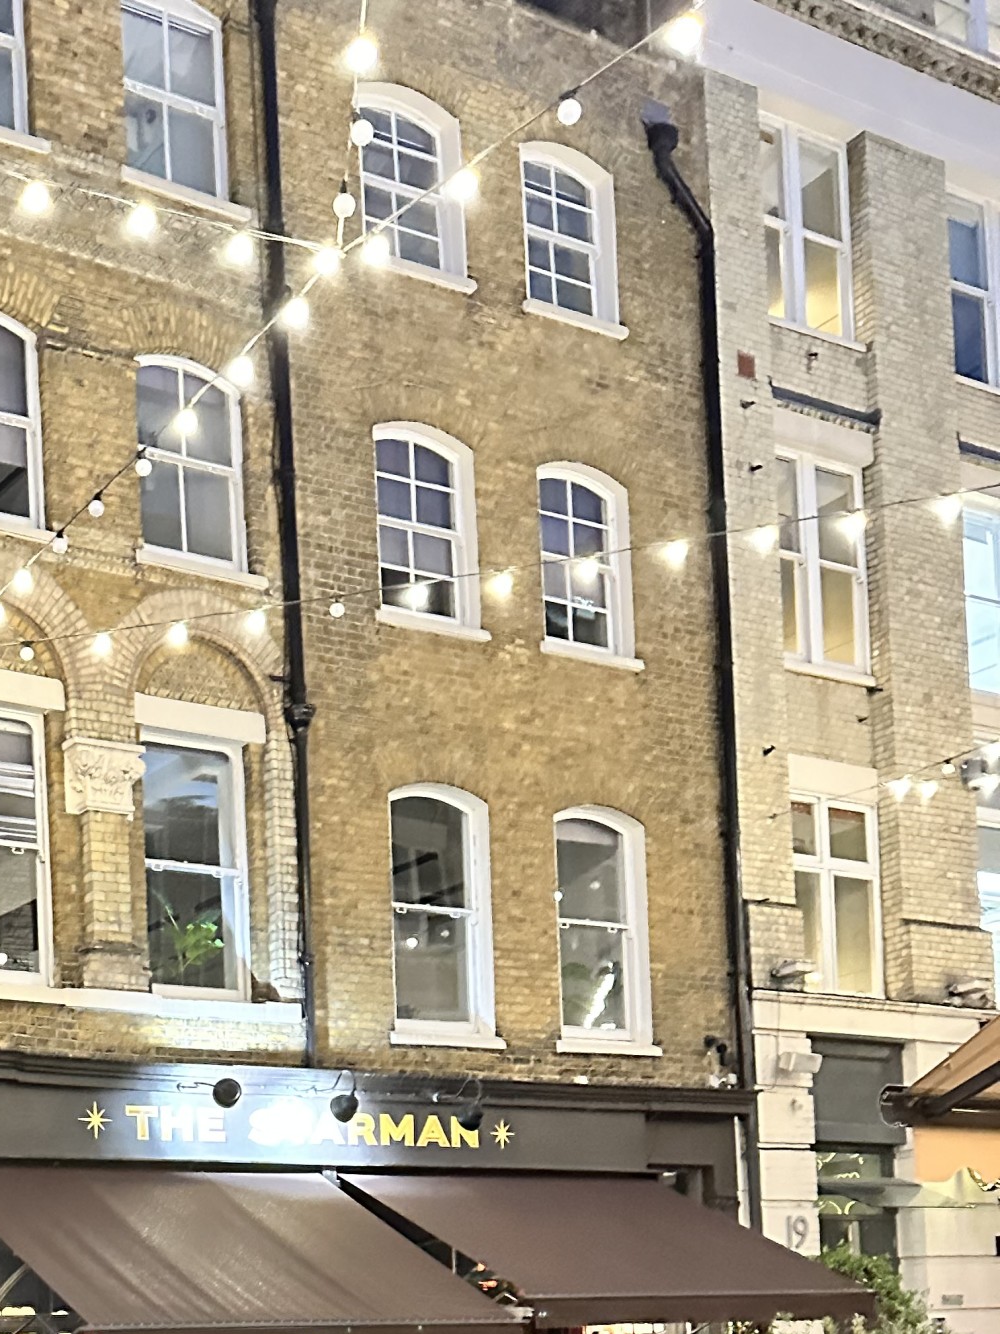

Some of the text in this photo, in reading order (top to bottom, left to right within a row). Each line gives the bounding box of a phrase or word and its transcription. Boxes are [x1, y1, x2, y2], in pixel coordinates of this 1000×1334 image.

[124, 1104, 480, 1149] THE SARMAN
[786, 1215, 809, 1249] 19
